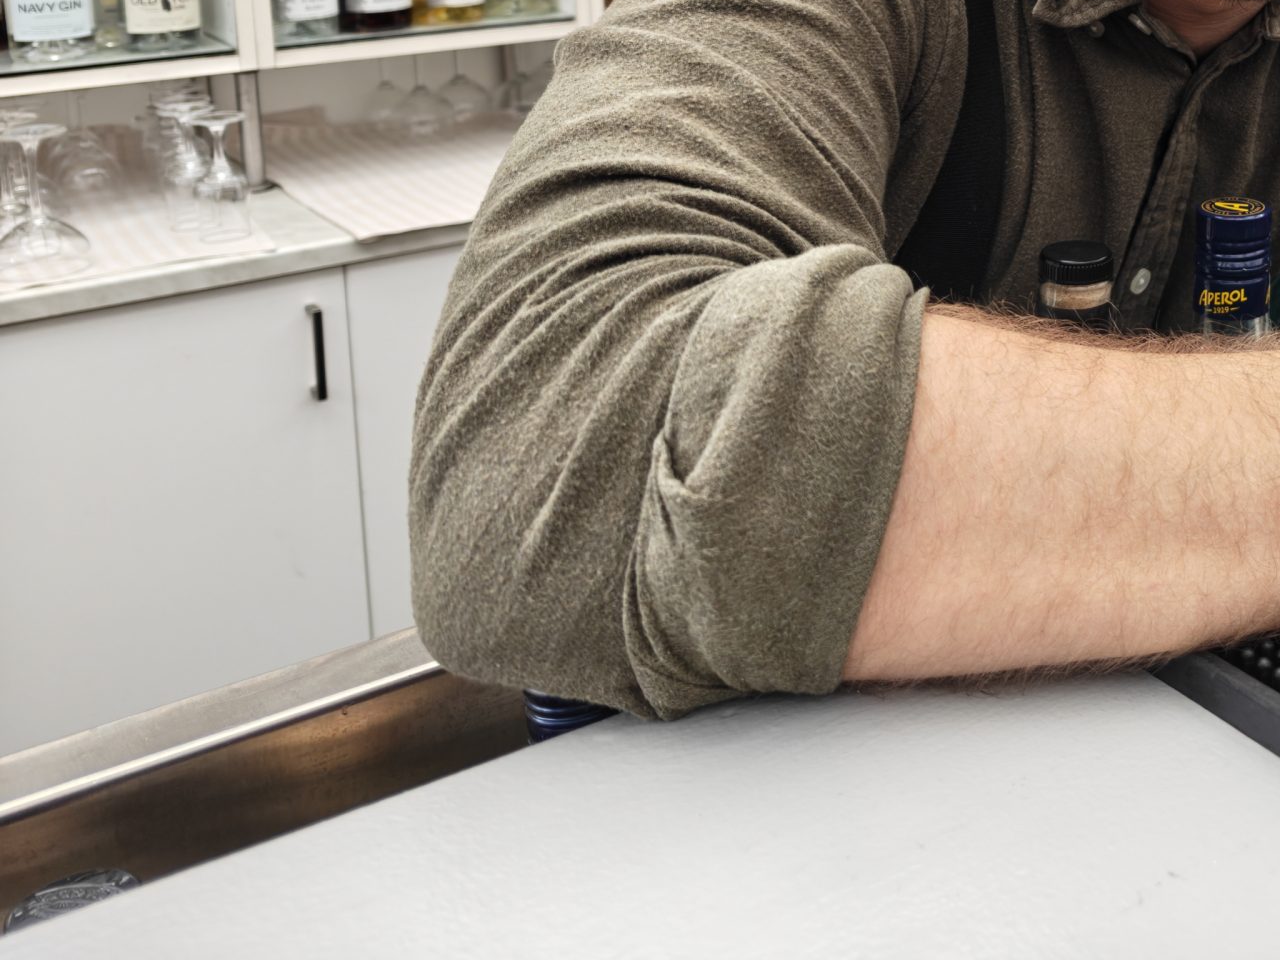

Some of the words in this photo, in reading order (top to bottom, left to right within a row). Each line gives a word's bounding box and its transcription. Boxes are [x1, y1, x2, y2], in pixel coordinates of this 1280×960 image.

[17, 2, 55, 14] NAVY
[58, 0, 82, 12] GIN
[1199, 288, 1248, 306] APEROL
[1212, 306, 1230, 314] 1919
